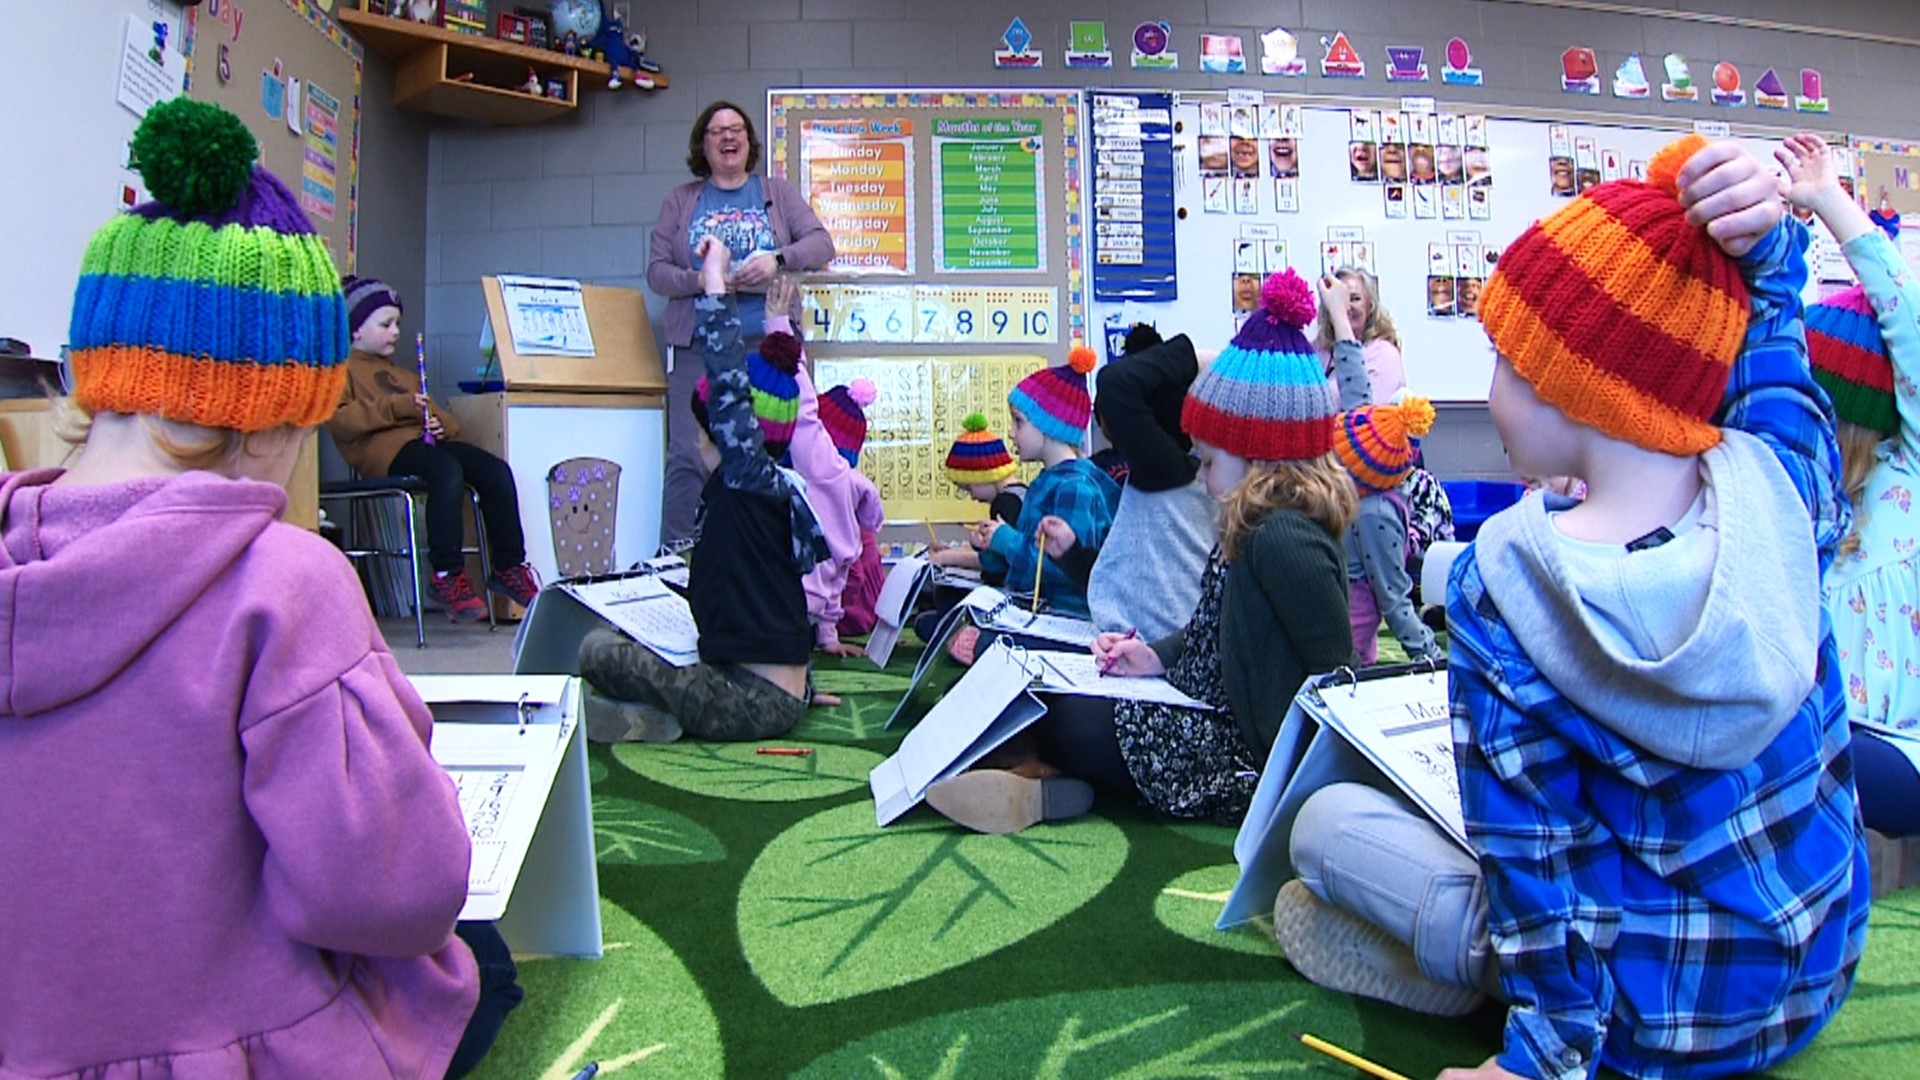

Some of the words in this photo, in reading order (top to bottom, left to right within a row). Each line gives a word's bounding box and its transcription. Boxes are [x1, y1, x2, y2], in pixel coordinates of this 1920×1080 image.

[219, 44, 231, 81] 5
[870, 121, 902, 134] Week
[937, 119, 980, 133] Months
[981, 120, 993, 133] of
[994, 121, 1010, 132] the
[1012, 119, 1036, 133] Year
[832, 145, 882, 159] Sunday
[970, 142, 1005, 152] January
[968, 152, 1006, 163] February
[830, 162, 883, 178] Monday
[975, 164, 1002, 173] March
[978, 173, 999, 183] April
[830, 180, 885, 195] Tuesday
[979, 183, 997, 194] May
[980, 195, 999, 205] June
[820, 198, 898, 214] Wednesday
[981, 204, 998, 215] July
[829, 216, 889, 232] Thursday
[976, 215, 1004, 226] August
[967, 225, 1012, 236] September
[836, 234, 879, 249] Friday
[972, 237, 1008, 246] October
[969, 247, 1012, 257] November
[968, 258, 1012, 267] December
[814, 309, 831, 333] 4
[850, 309, 867, 334] 5
[886, 309, 902, 334] 6
[921, 310, 939, 334] 7
[956, 309, 974, 335] 8
[992, 310, 1009, 335] 9
[1023, 310, 1049, 336] 10
